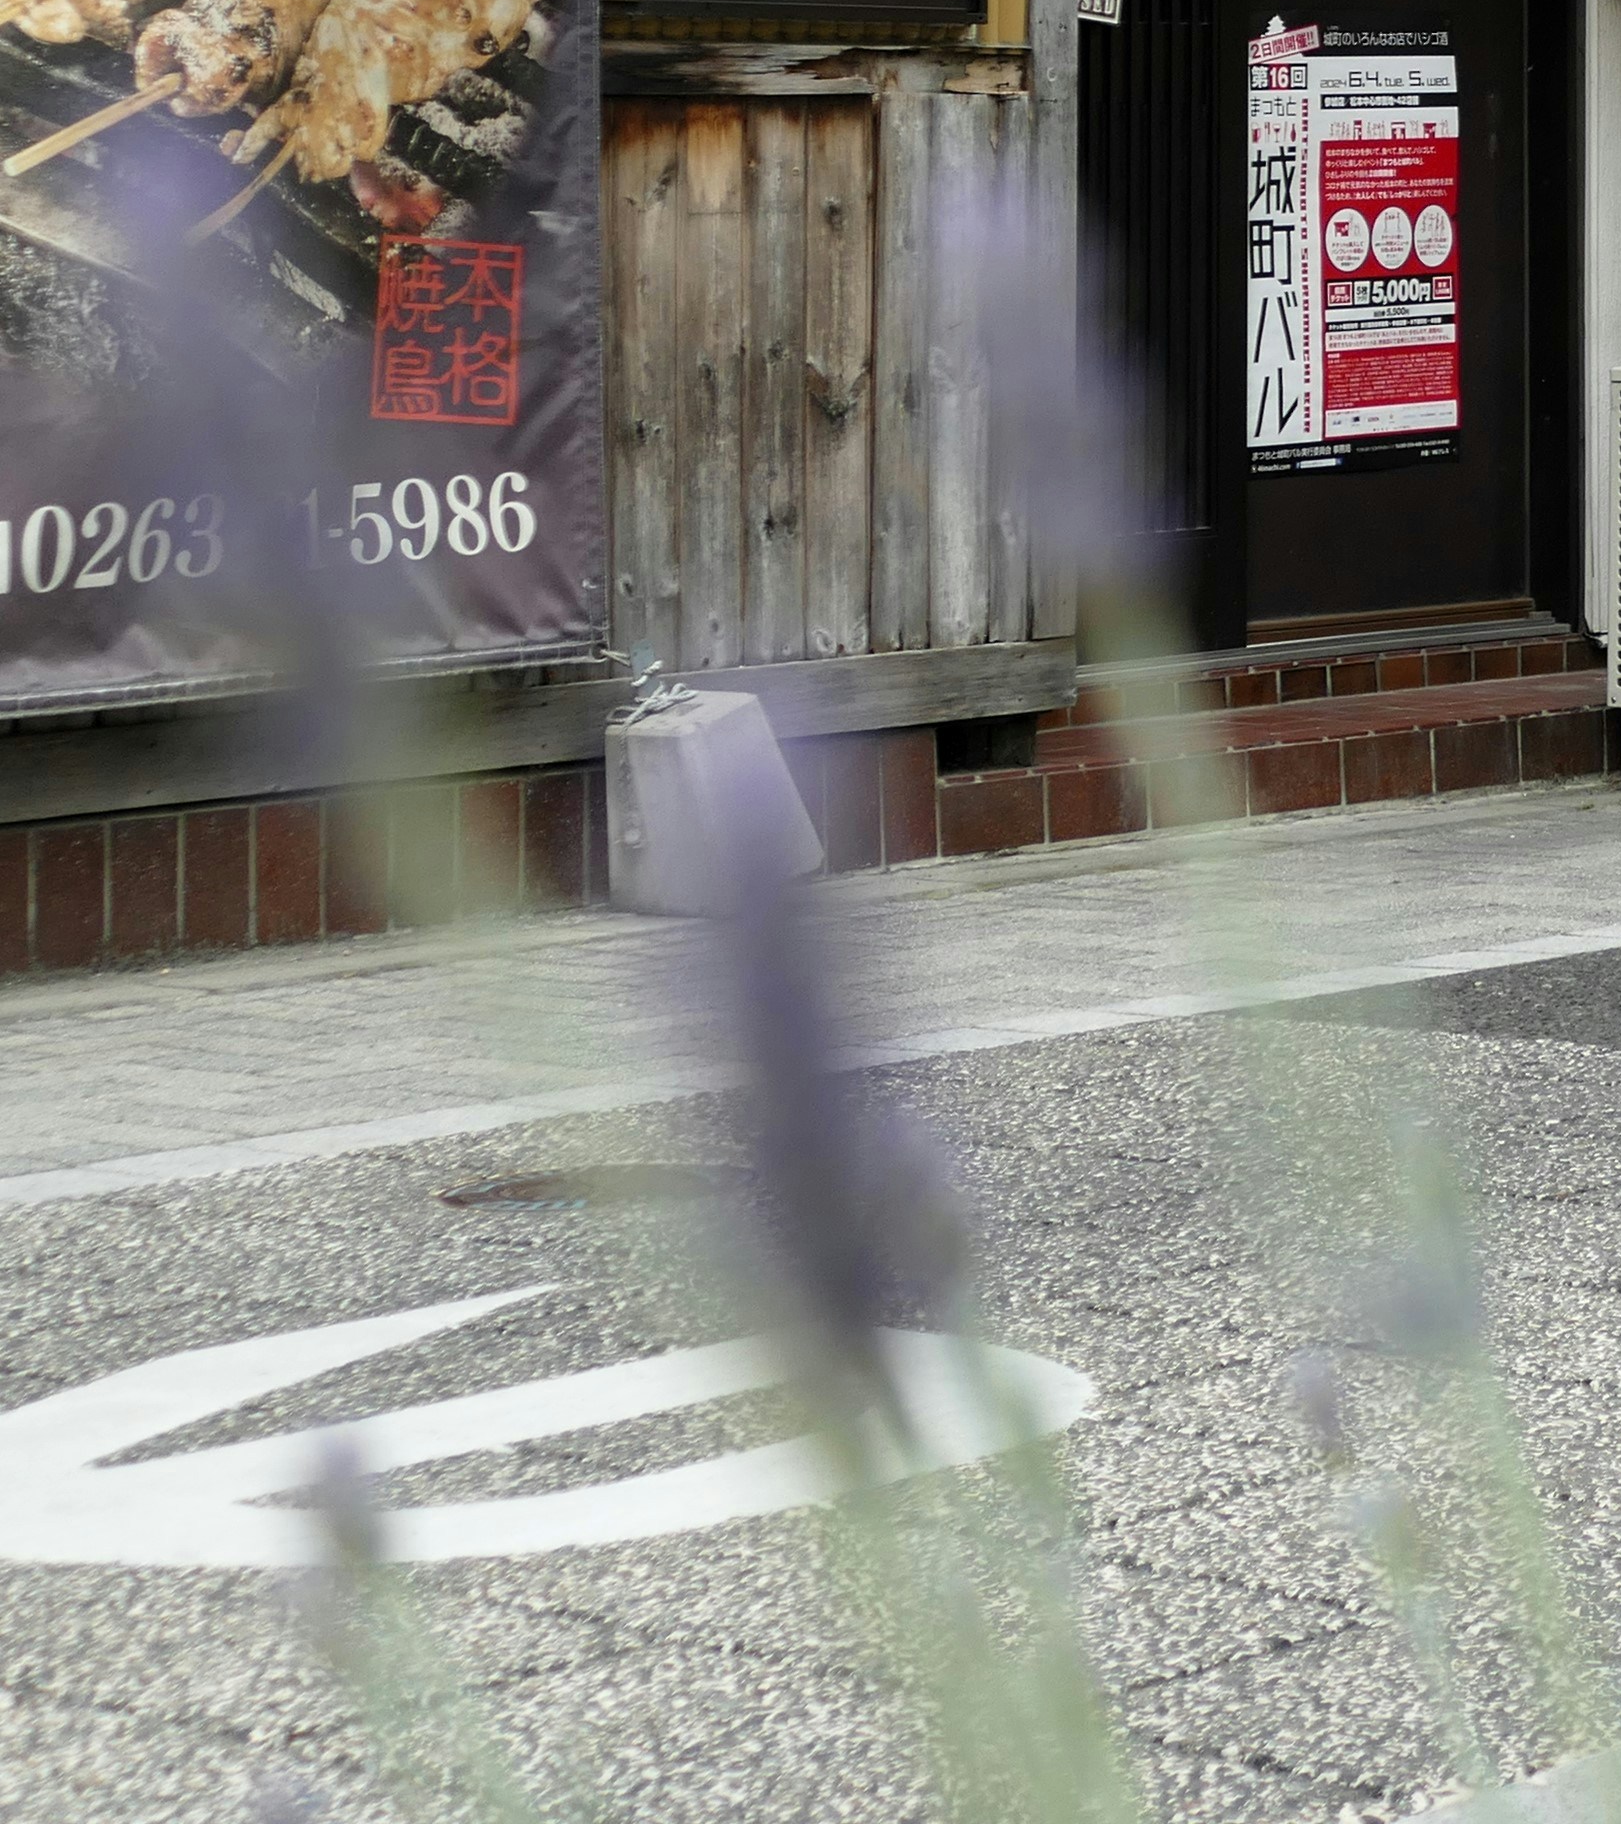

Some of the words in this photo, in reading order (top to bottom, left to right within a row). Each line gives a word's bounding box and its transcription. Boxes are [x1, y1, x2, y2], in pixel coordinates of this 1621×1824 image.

[1250, 65, 1307, 89] 第16回
[1320, 79, 1347, 88] 2024
[1250, 96, 1297, 117] まつもと
[1249, 145, 1299, 438] 城町バル
[1371, 277, 1431, 305] 5,000円
[377, 255, 446, 416] 焼鳥
[444, 247, 519, 408] 本格
